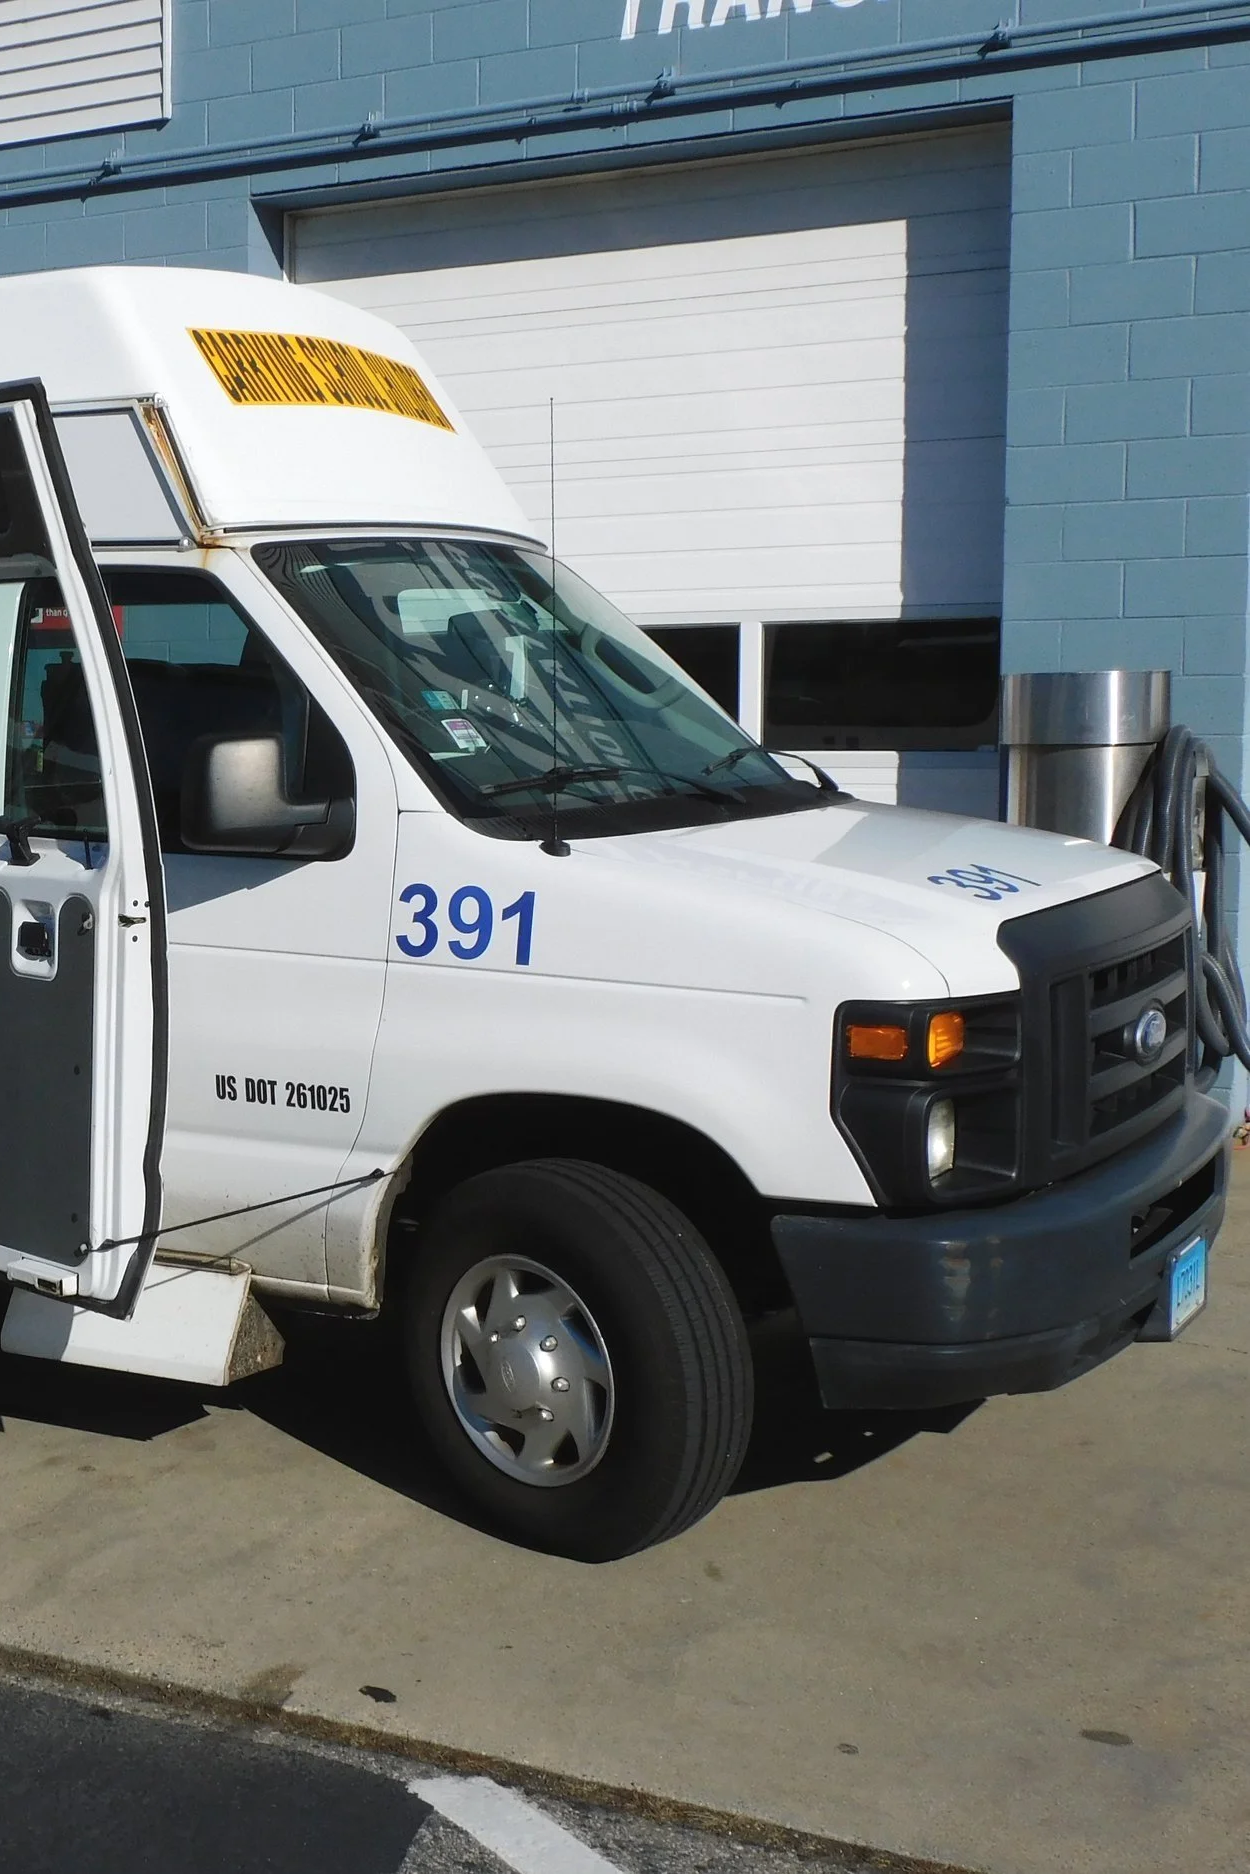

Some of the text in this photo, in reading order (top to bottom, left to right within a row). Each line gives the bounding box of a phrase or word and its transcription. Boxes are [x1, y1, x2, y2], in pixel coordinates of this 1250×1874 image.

[295, 336, 393, 411] SCHOOL
[926, 863, 1042, 901] 391
[395, 883, 536, 966] 391
[215, 1074, 351, 1114] US DOT 261025
